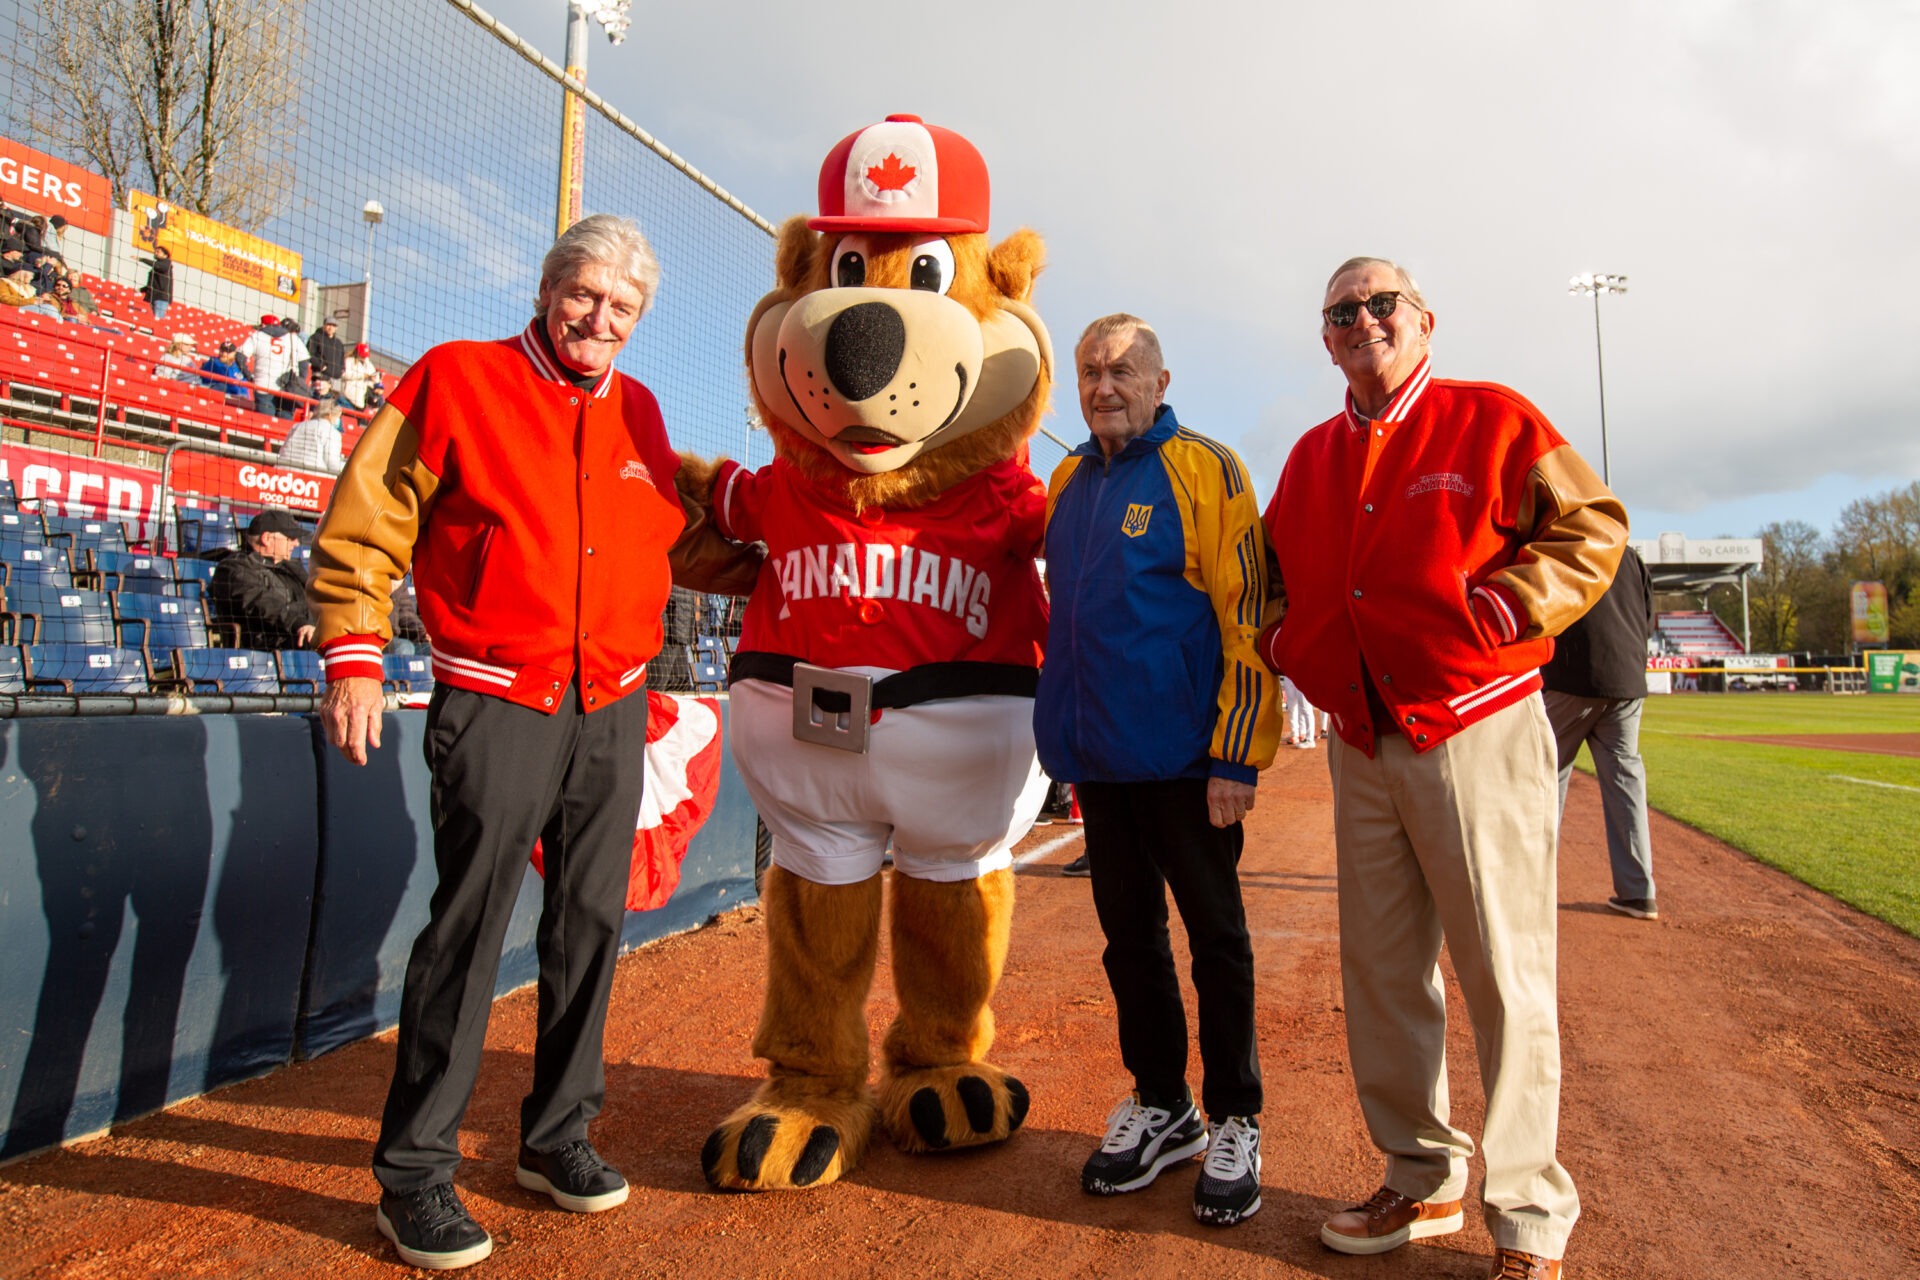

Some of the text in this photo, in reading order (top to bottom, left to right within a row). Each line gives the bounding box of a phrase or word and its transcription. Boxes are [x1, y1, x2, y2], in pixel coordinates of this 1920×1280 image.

[0, 157, 82, 208] GERS
[186, 230, 228, 253] TROPICAL
[270, 337, 283, 355] 5
[239, 465, 319, 498] Gordon
[1405, 480, 1475, 499] CANADIANS
[285, 496, 318, 509] SERVICE
[1715, 545, 1751, 555] CARBS
[772, 542, 991, 640] ANADIANS
